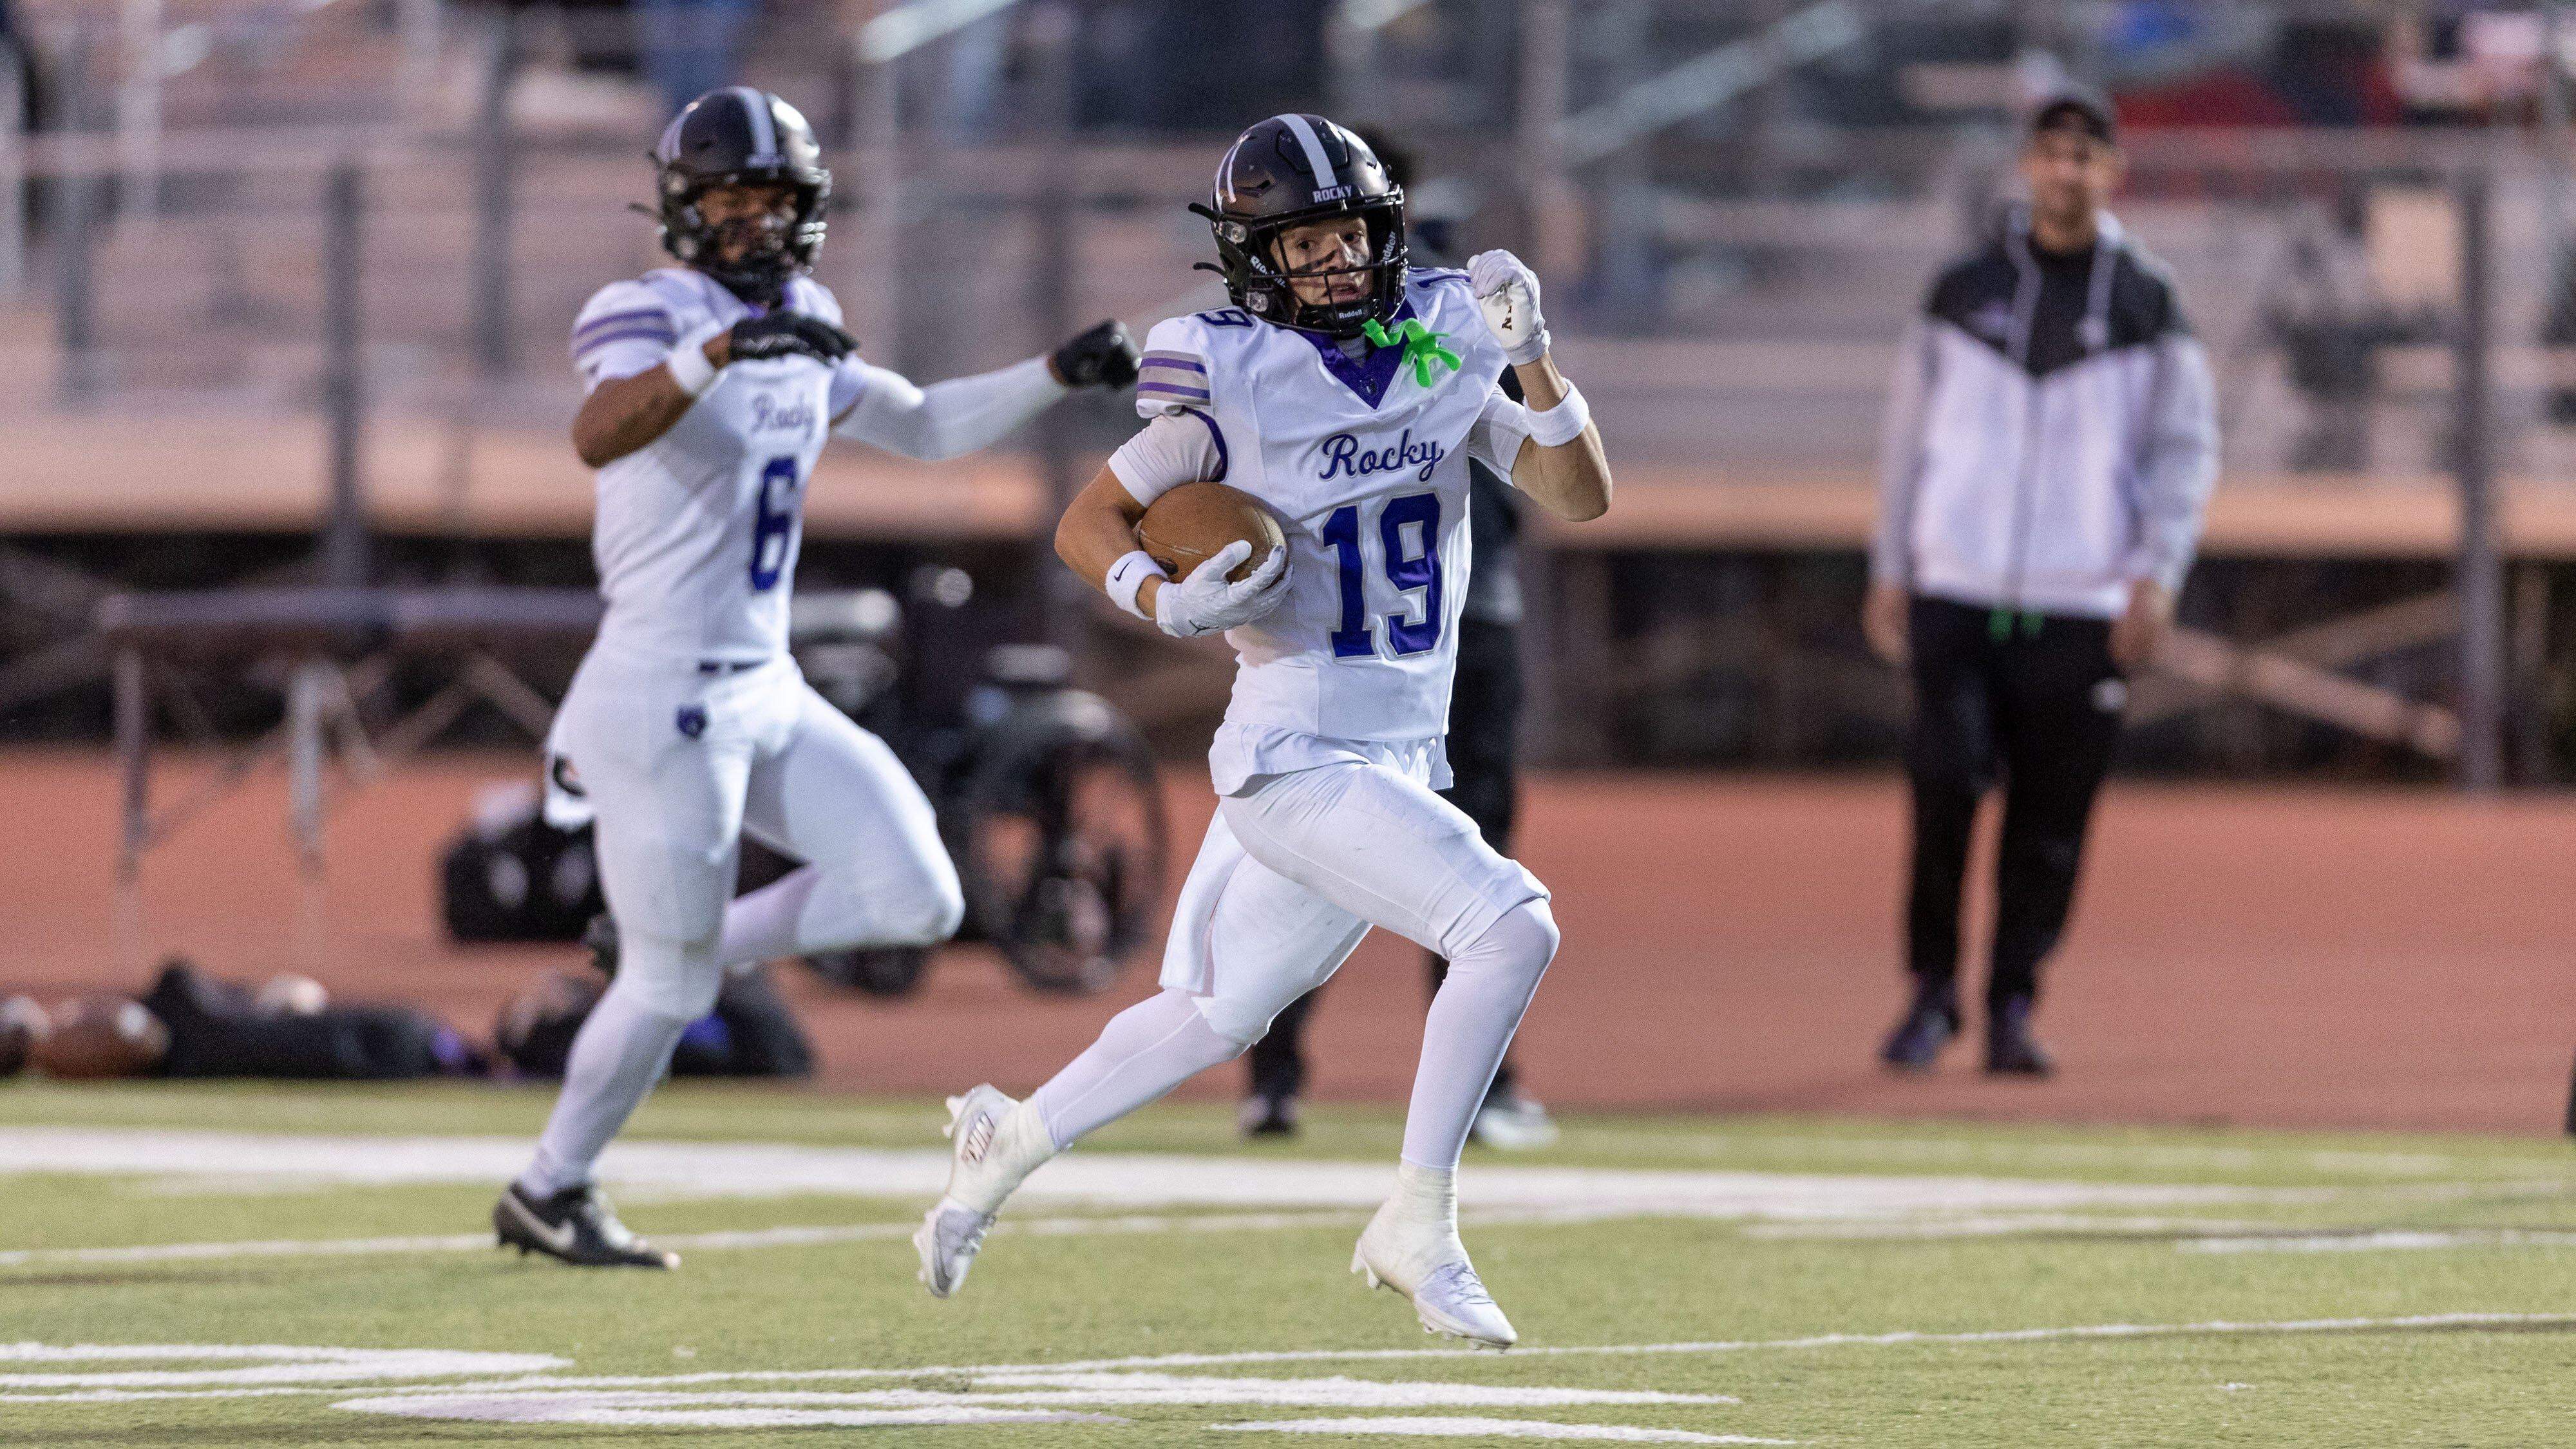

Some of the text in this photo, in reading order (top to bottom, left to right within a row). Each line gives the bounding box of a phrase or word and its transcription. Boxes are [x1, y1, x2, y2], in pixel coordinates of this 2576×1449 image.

[1312, 185, 1352, 204] ROCKY
[1381, 231, 1396, 263] iddell
[1250, 255, 1286, 288] Ridell
[1338, 309, 1363, 319] Riddell
[1319, 428, 1444, 482] Rocky
[750, 455, 797, 591] 6
[1322, 492, 1443, 658] 19
